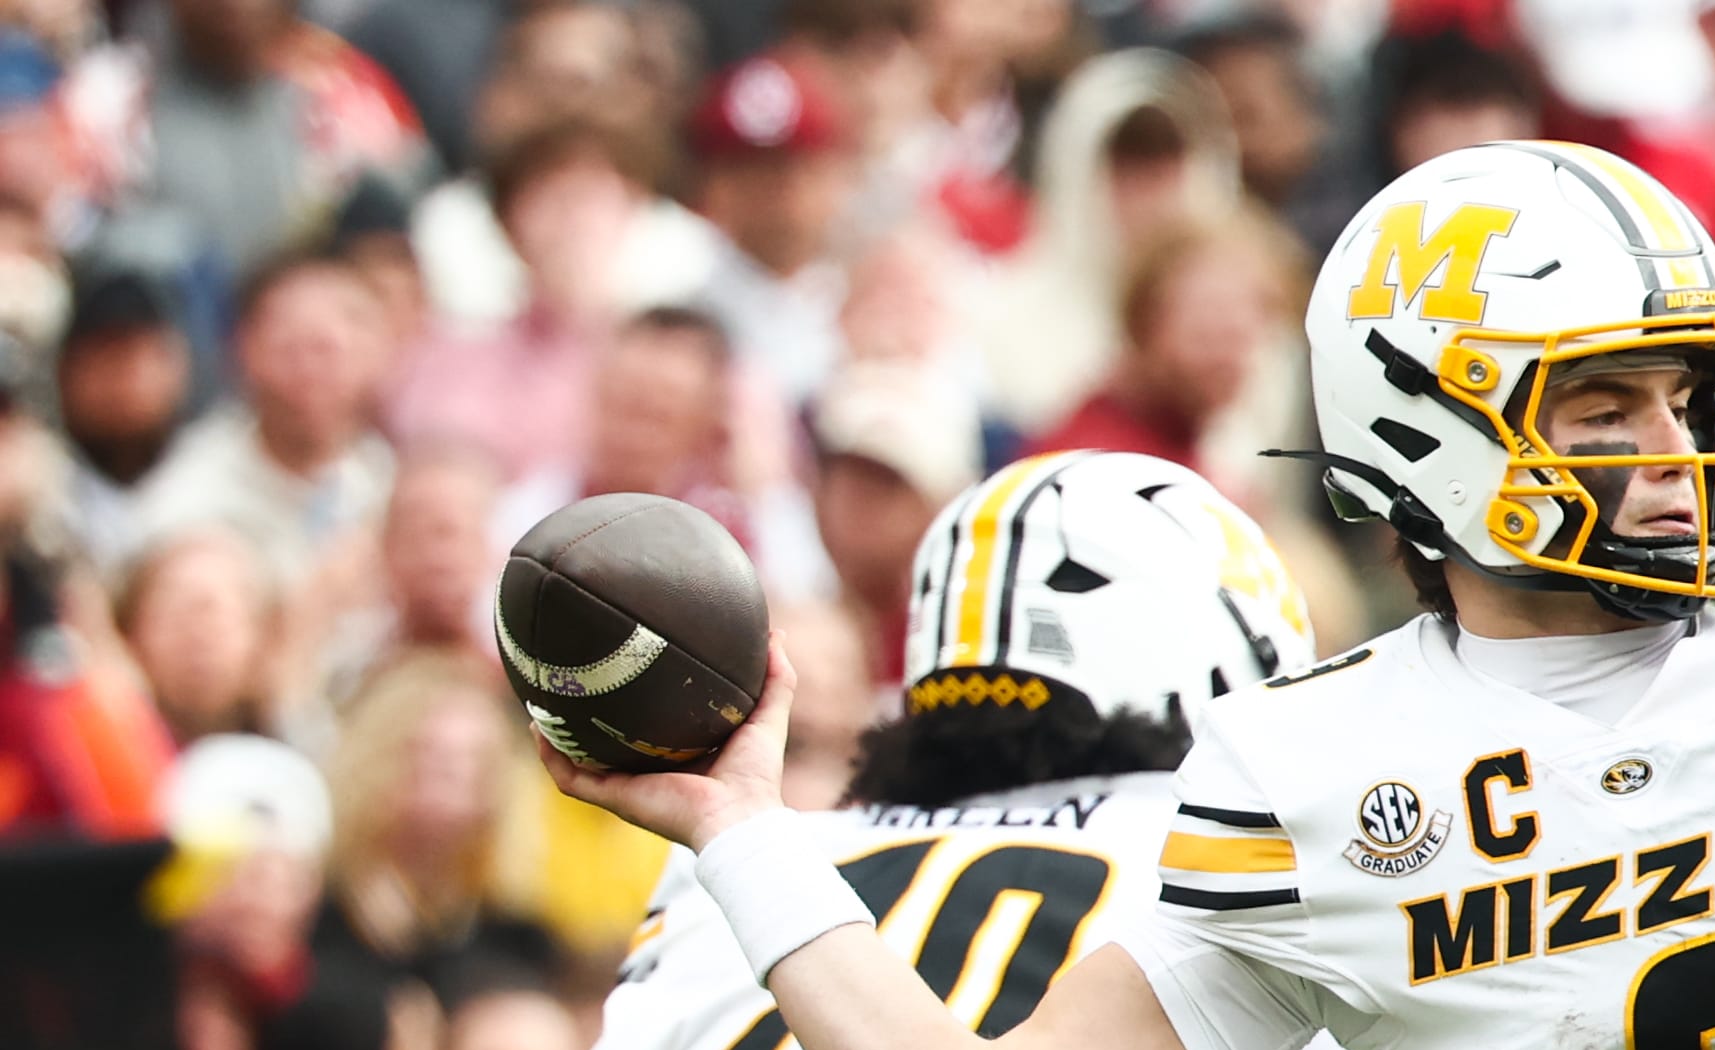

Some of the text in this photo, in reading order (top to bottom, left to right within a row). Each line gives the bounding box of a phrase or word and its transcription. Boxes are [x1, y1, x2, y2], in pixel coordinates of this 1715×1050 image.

[1347, 201, 1520, 325] M
[1361, 783, 1420, 844] SEC
[1461, 748, 1541, 864] C
[1361, 832, 1442, 874] GRADUATE
